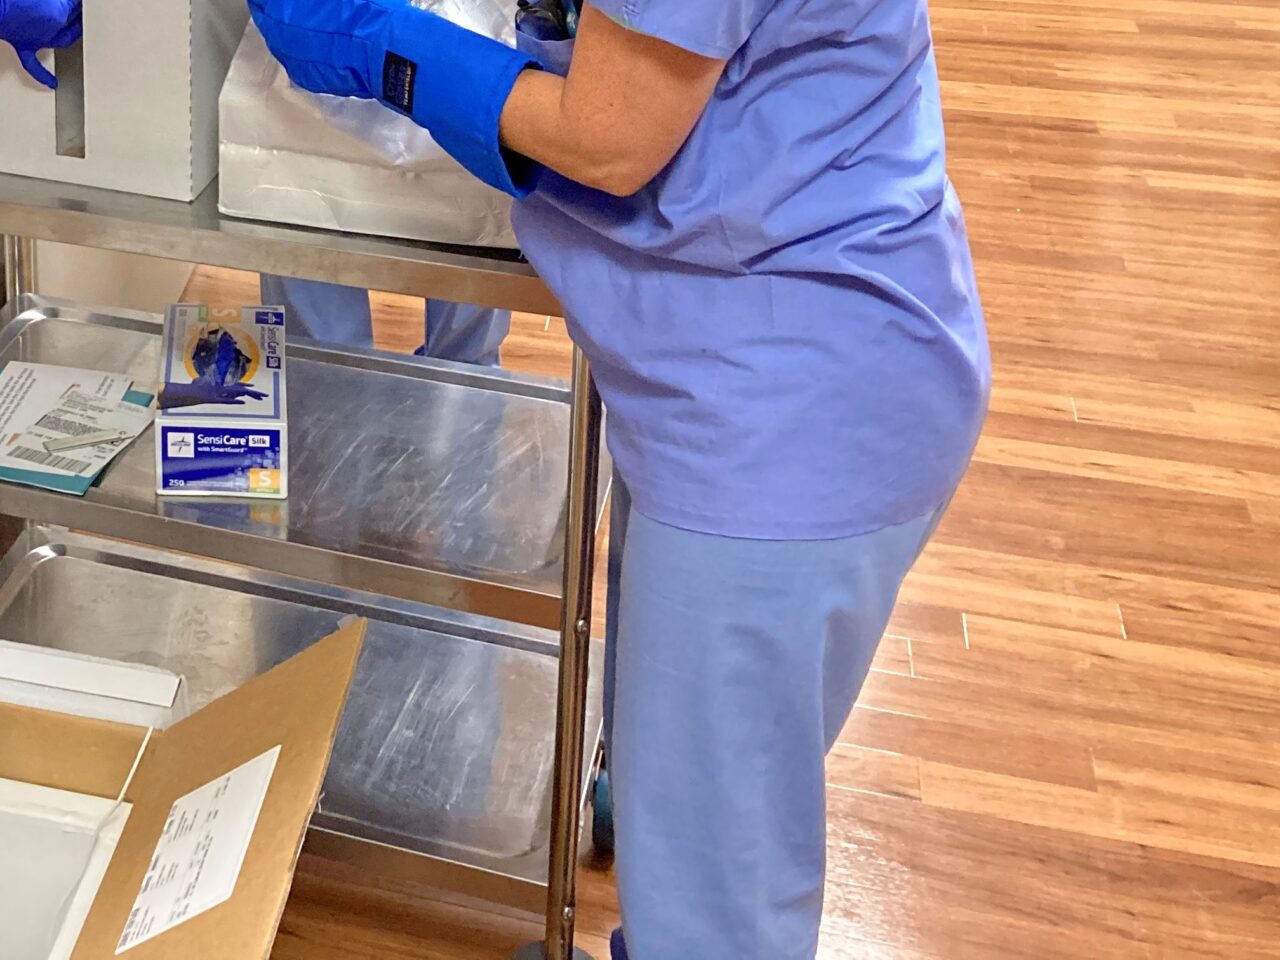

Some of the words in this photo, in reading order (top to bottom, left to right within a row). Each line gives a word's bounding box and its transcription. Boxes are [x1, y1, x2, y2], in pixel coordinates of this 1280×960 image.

[251, 436, 267, 445] Silk
[168, 479, 185, 487] 250
[259, 471, 272, 487] S
